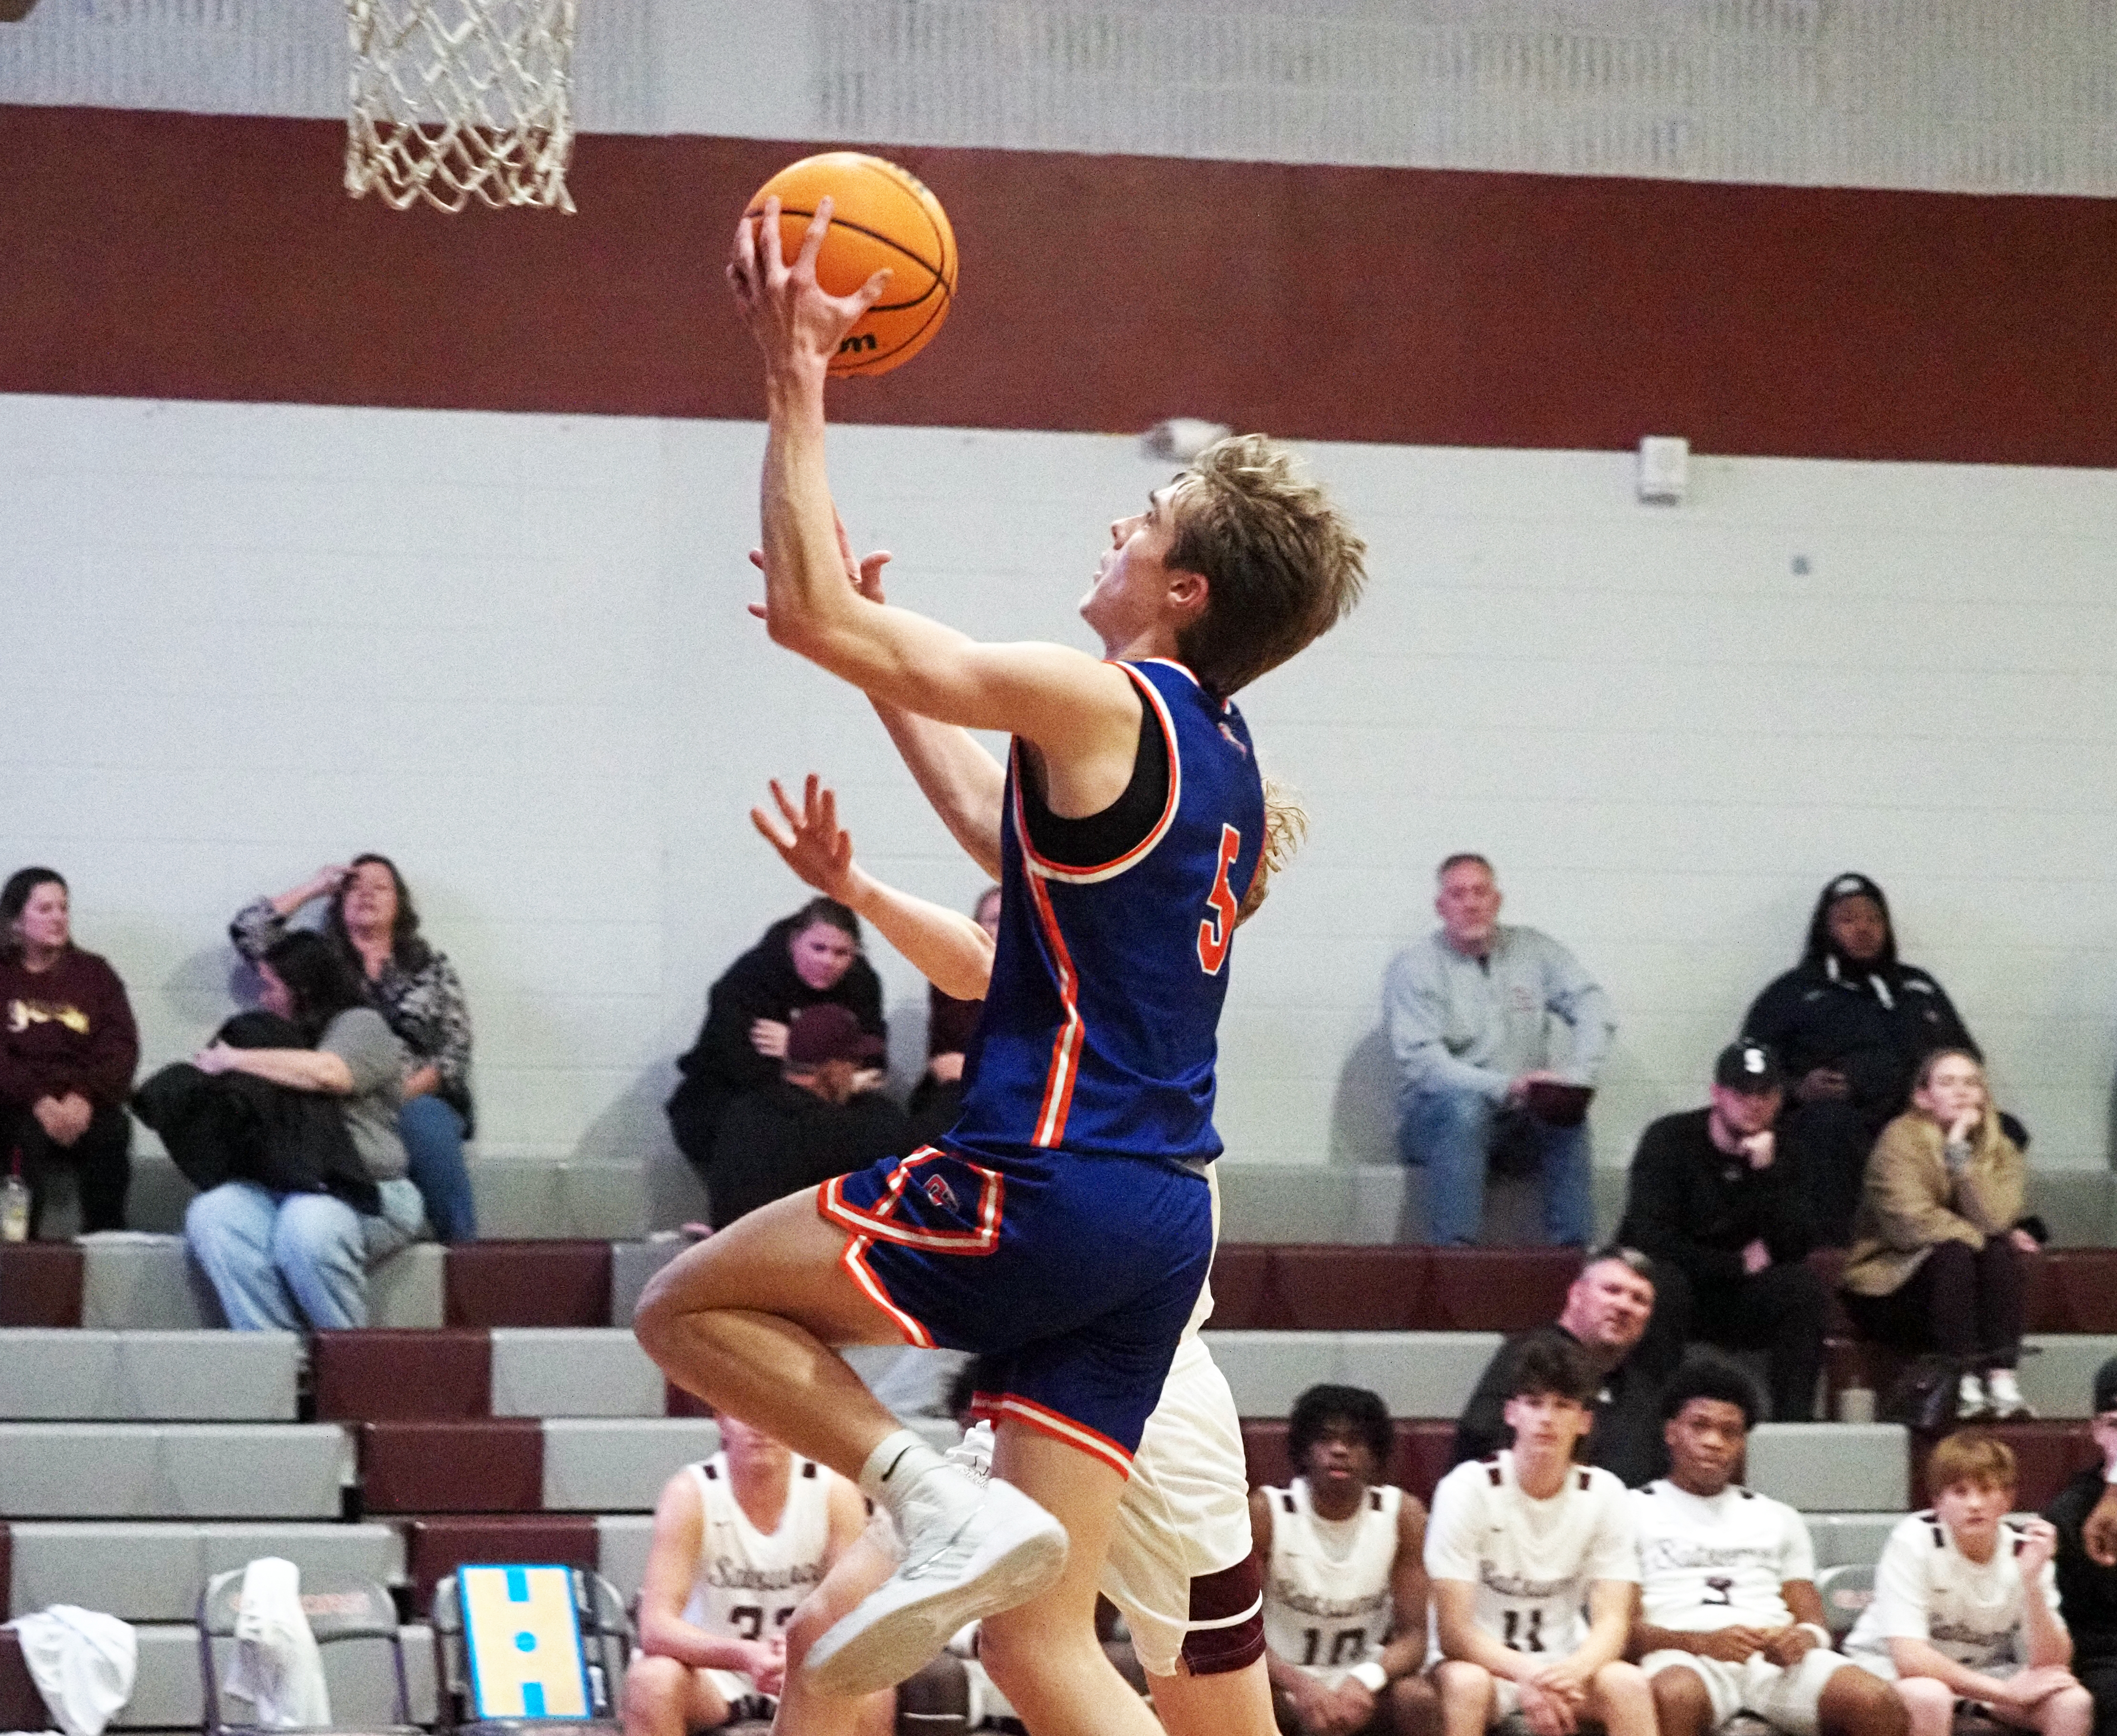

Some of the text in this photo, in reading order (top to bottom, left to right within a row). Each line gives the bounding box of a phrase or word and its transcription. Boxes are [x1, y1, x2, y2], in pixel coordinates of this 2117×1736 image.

[1197, 823, 1241, 976] 5
[1744, 1048, 1766, 1073] S
[1303, 1628, 1366, 1664] 10
[1503, 1610, 1544, 1651] 11
